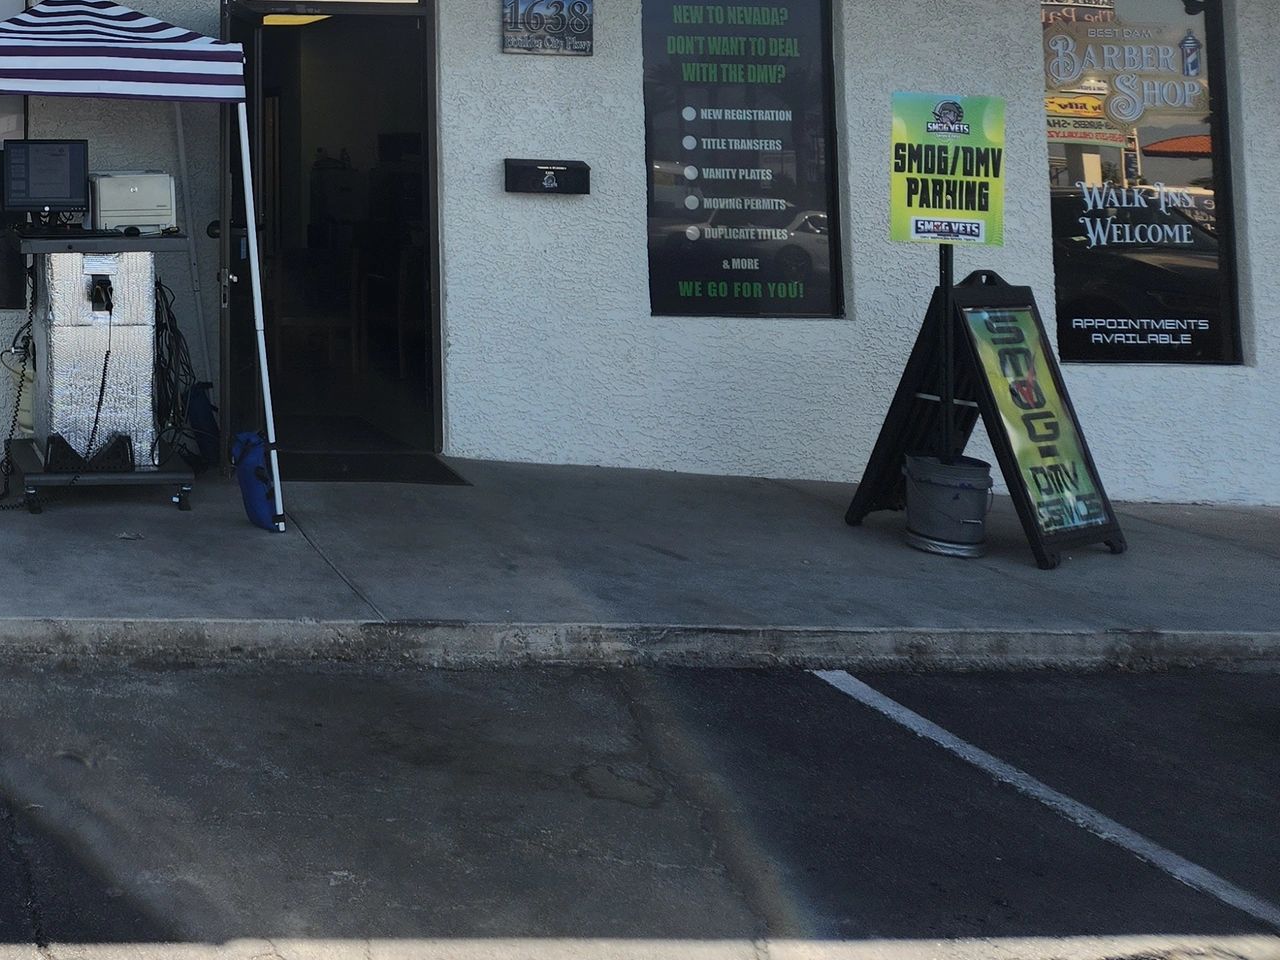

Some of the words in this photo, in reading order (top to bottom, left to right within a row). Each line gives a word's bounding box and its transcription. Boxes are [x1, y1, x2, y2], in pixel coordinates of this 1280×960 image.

[673, 5, 704, 25] NEW
[706, 5, 724, 25] TO
[727, 6, 788, 26] NEVADA?
[1088, 28, 1119, 38] BEST
[667, 36, 705, 56] DON'T
[707, 36, 747, 57] WANT
[749, 37, 766, 57] TO
[768, 37, 800, 58] DEAL
[1048, 35, 1177, 85] BARBER
[682, 63, 718, 83] WITH
[720, 63, 745, 83] THE
[747, 64, 786, 84] DMV?
[1109, 72, 1201, 122] SHOP
[700, 108, 723, 120] NEW
[724, 109, 792, 121] REGISTRATION
[950, 123, 970, 133] VETS
[701, 138, 727, 150] TITLE
[728, 138, 782, 151] TRANSFERS
[894, 143, 1003, 178] SMOG/DMV
[702, 167, 736, 180] VANITY
[738, 168, 773, 180] PLATES
[906, 177, 990, 212] PARKING
[703, 198, 742, 210] MOVING
[743, 198, 786, 210] PERMITS
[704, 227, 755, 240] DUPLICATE
[757, 228, 788, 240] TITLES
[917, 221, 949, 233] SMOG
[952, 222, 980, 235] VETS
[1078, 216, 1194, 249] WELCOME
[722, 258, 730, 269] &
[732, 258, 760, 270] MORE
[678, 281, 702, 297] WE
[707, 281, 728, 297] GO
[733, 281, 762, 297] FOR
[767, 281, 804, 298] YOU!
[1072, 318, 1210, 330] APPOINTMENTS
[1091, 333, 1192, 344] AVAILABLE
[1029, 462, 1079, 496] DMV
